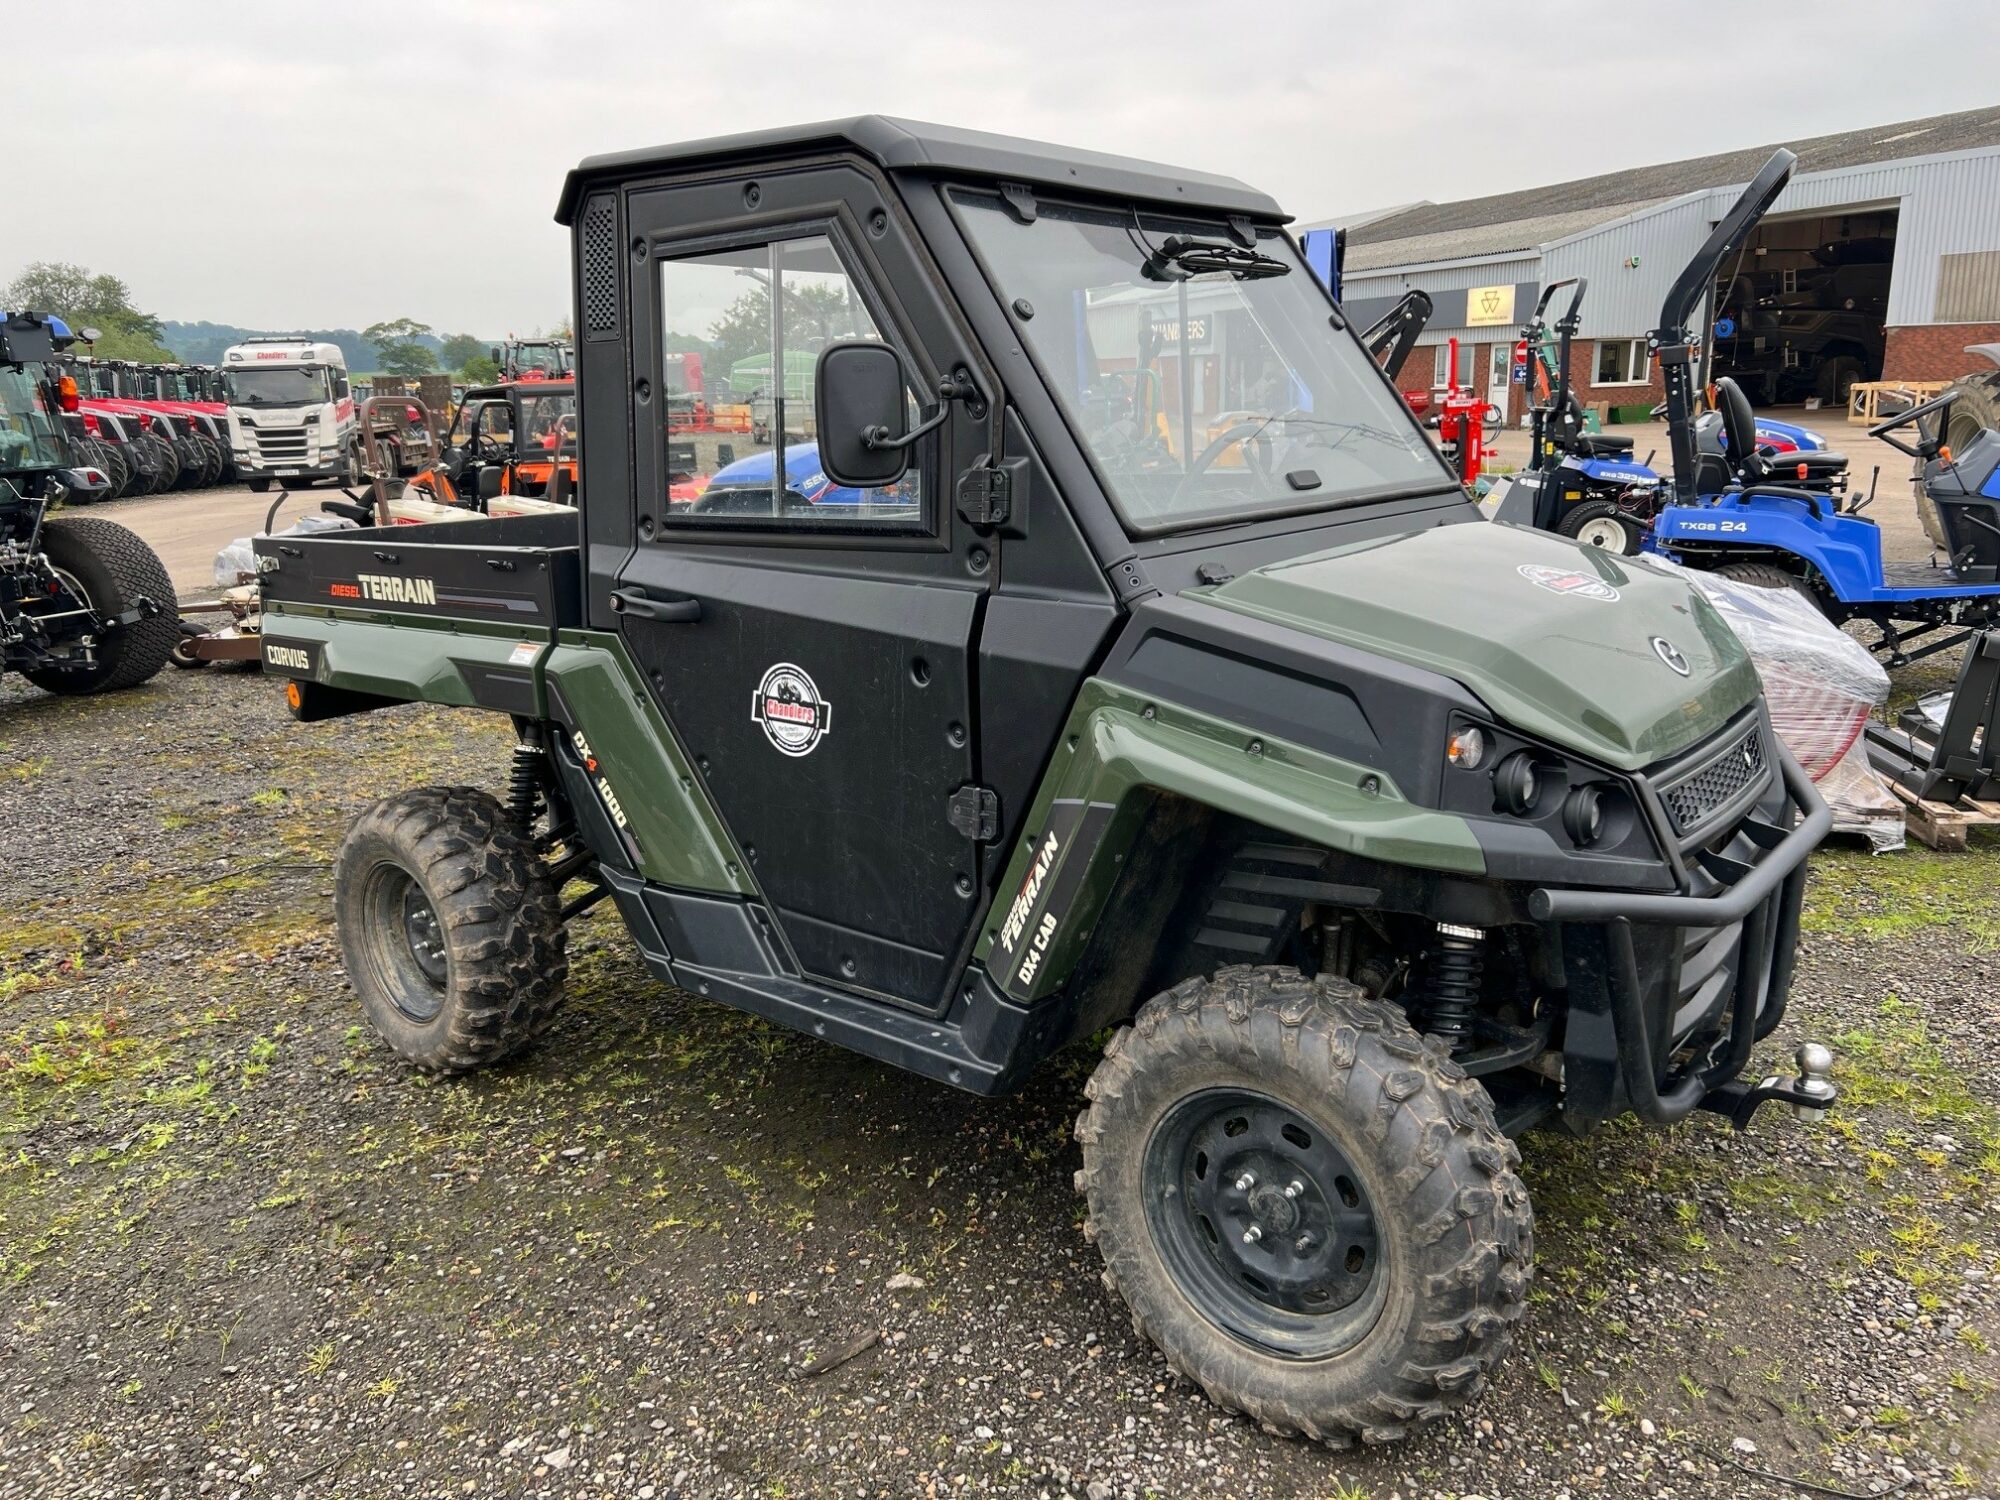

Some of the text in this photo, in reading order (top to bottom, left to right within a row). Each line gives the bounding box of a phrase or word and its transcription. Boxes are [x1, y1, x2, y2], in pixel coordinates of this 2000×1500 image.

[1679, 521, 1748, 532] TXGS 24
[330, 574, 436, 605] DIESEL TERRAIN
[266, 645, 310, 670] CORVUS
[767, 700, 815, 723] Chandlers
[573, 730, 627, 828] DX4 1000
[1002, 830, 1059, 954] TERRAIN
[1001, 894, 1021, 942] CORVUS
[1018, 912, 1058, 986] DX4 CAB
